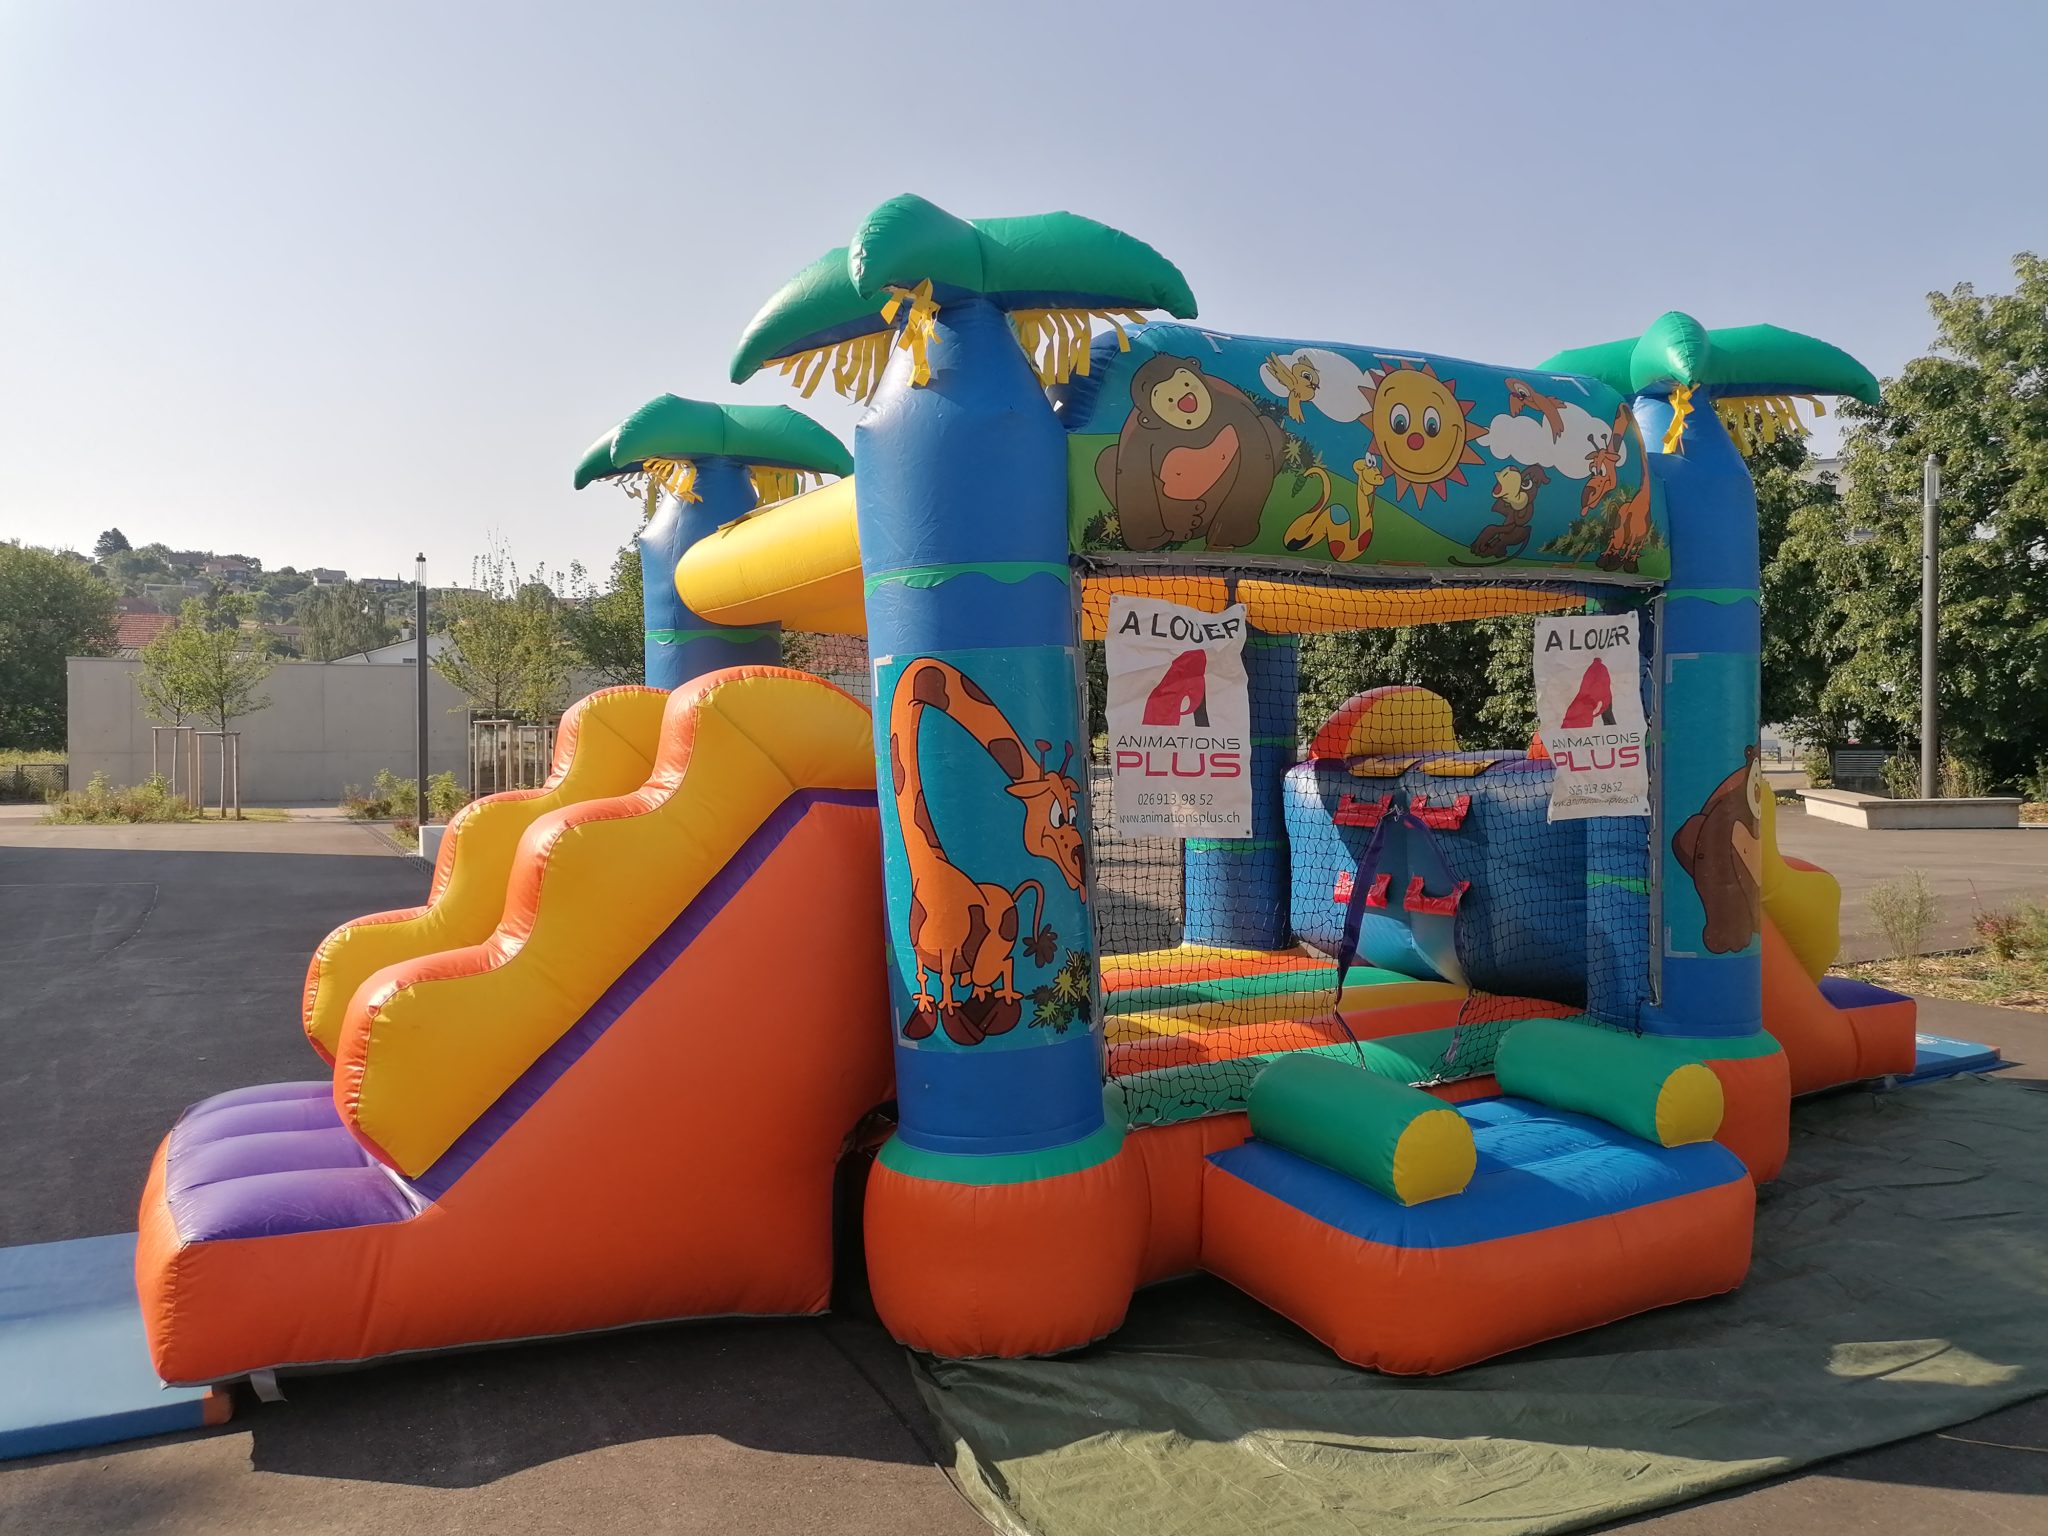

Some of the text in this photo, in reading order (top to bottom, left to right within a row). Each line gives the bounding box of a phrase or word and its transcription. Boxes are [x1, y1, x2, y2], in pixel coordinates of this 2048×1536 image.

[1119, 611, 1240, 643] A LOUER
[1545, 625, 1631, 652] A LOUER
[1116, 736, 1241, 750] ANIMATIONS
[1116, 751, 1241, 777] PLUS
[1554, 746, 1640, 771] PLUS
[1138, 793, 1213, 805] 026 913 98 52
